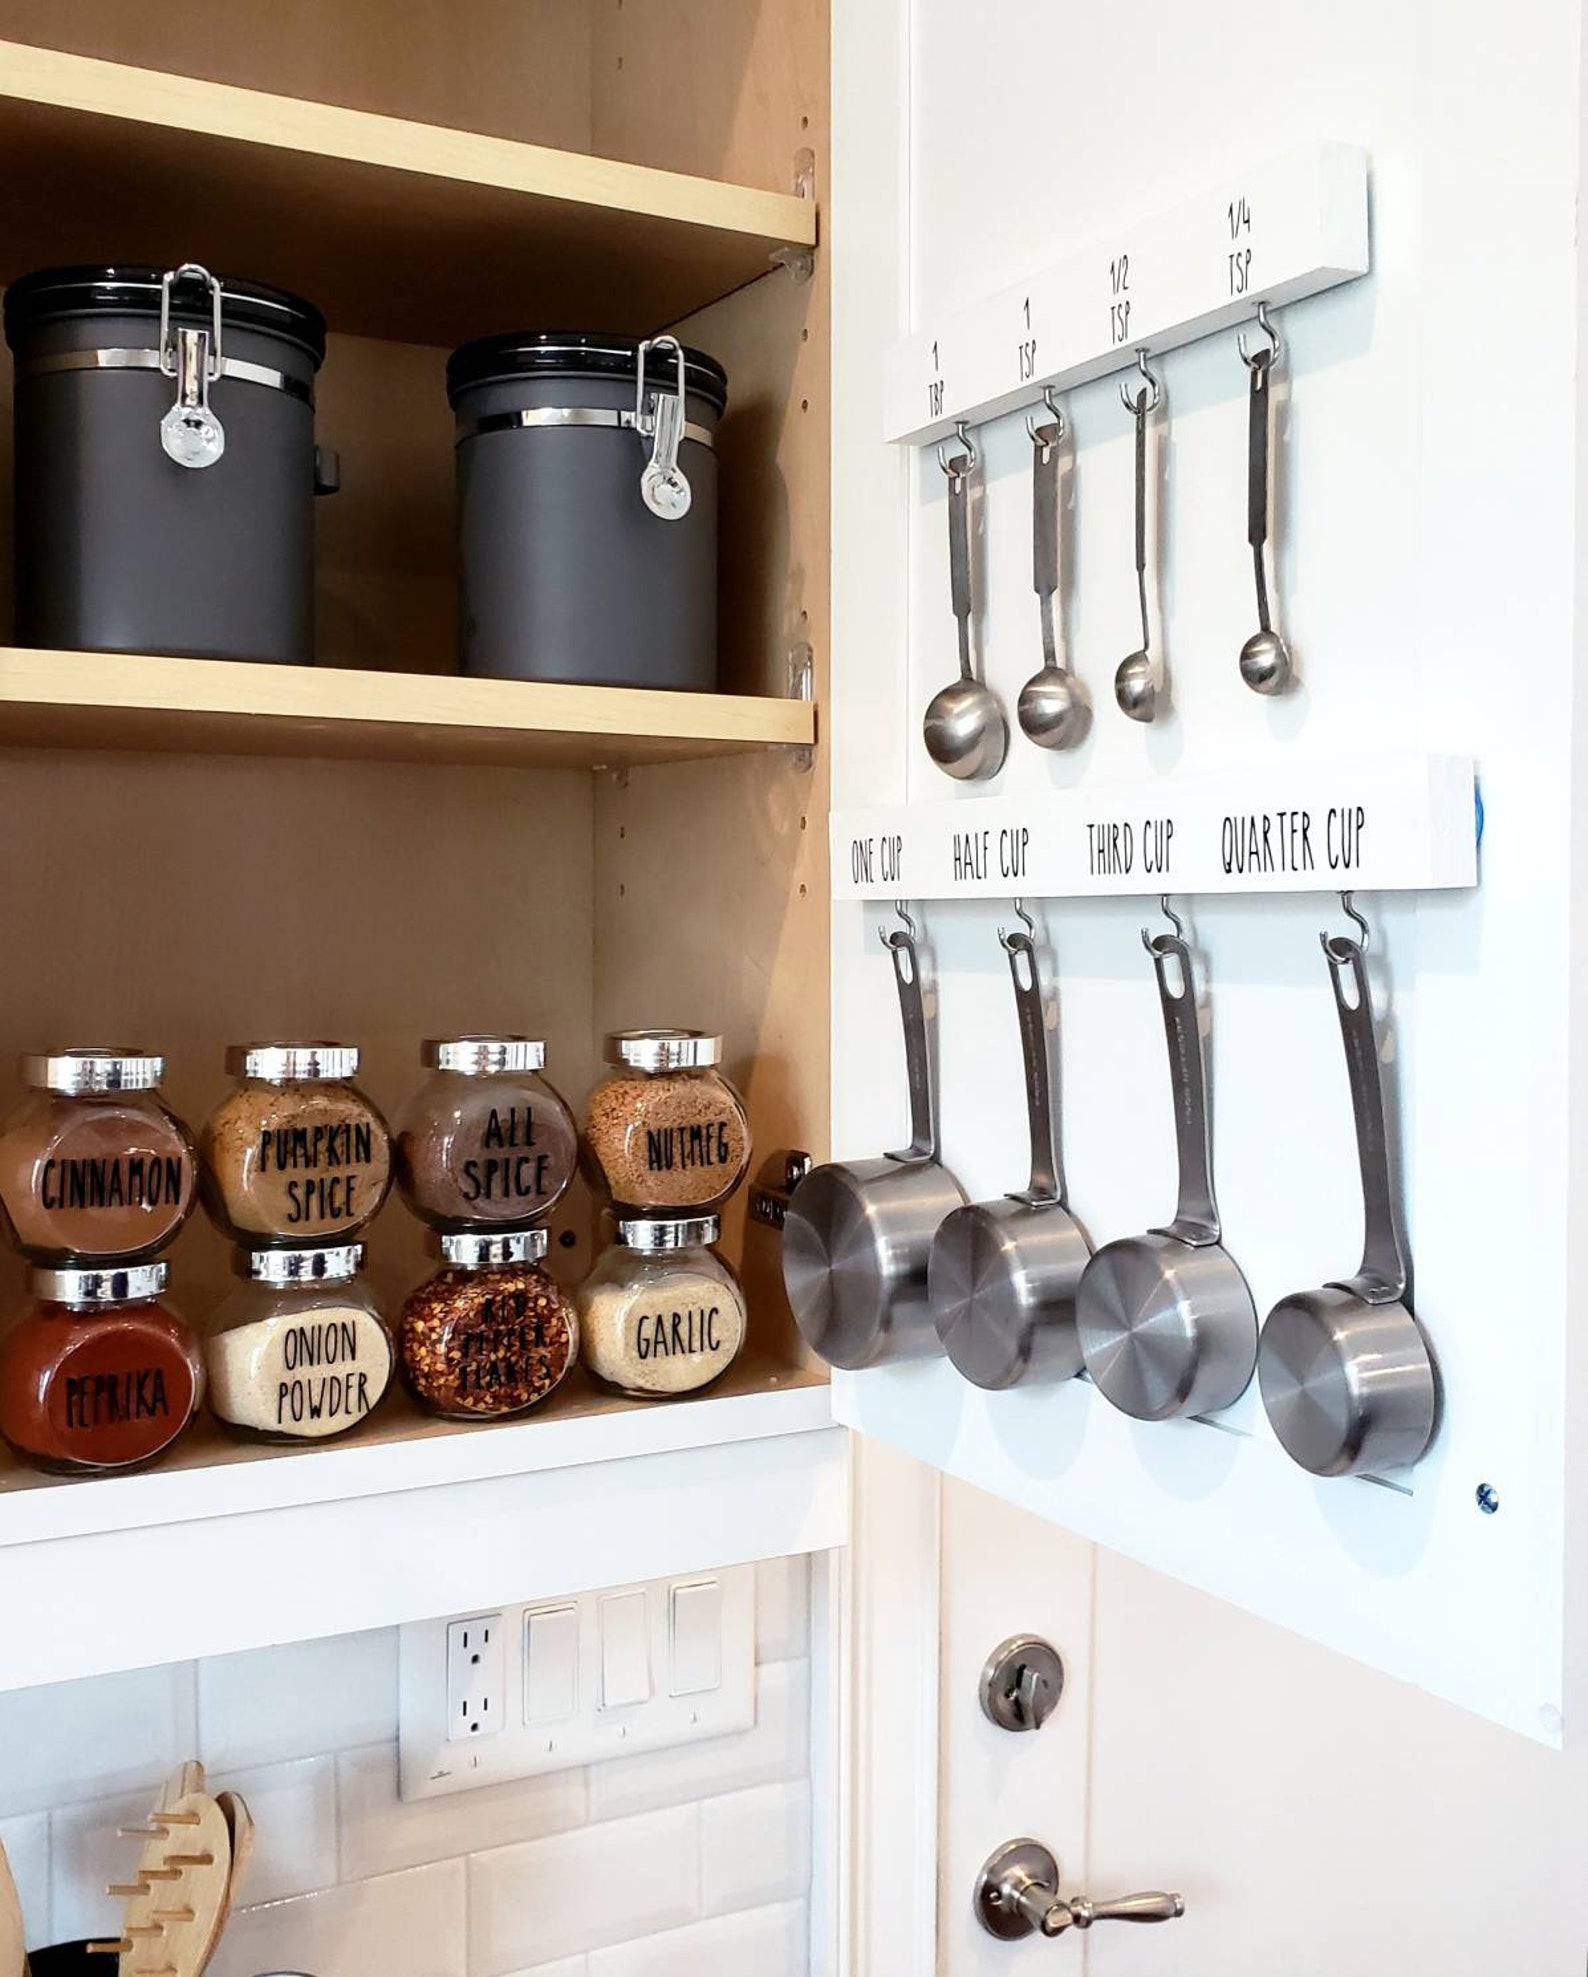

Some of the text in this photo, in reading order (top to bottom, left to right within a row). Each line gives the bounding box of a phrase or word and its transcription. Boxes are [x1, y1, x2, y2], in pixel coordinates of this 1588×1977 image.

[1228, 197, 1251, 240] 1/4
[1110, 255, 1129, 294] 1/2
[1229, 248, 1252, 297] TSP
[1024, 297, 1031, 330] 1
[1111, 301, 1131, 345] TSP
[932, 341, 939, 372] 1
[1019, 340, 1037, 383] TSP
[928, 380, 945, 419] TBP
[852, 835, 903, 883] ONE CUP
[953, 827, 1029, 881] HALF CUP
[1086, 819, 1174, 875] THIRD CUP
[1222, 806, 1366, 874] QUARTER CUP
[260, 1123, 371, 1172] PUMPKIN
[481, 1107, 536, 1149] ALL
[647, 1121, 729, 1172] NUTMEG
[42, 1157, 182, 1209] CINNAMON
[288, 1175, 357, 1223] SPICE
[462, 1154, 549, 1200] SPICE
[284, 1320, 357, 1370] ONION
[636, 1307, 721, 1360] GARLIC
[66, 1368, 169, 1428] PEPRIKA
[278, 1372, 370, 1424] POWDER
